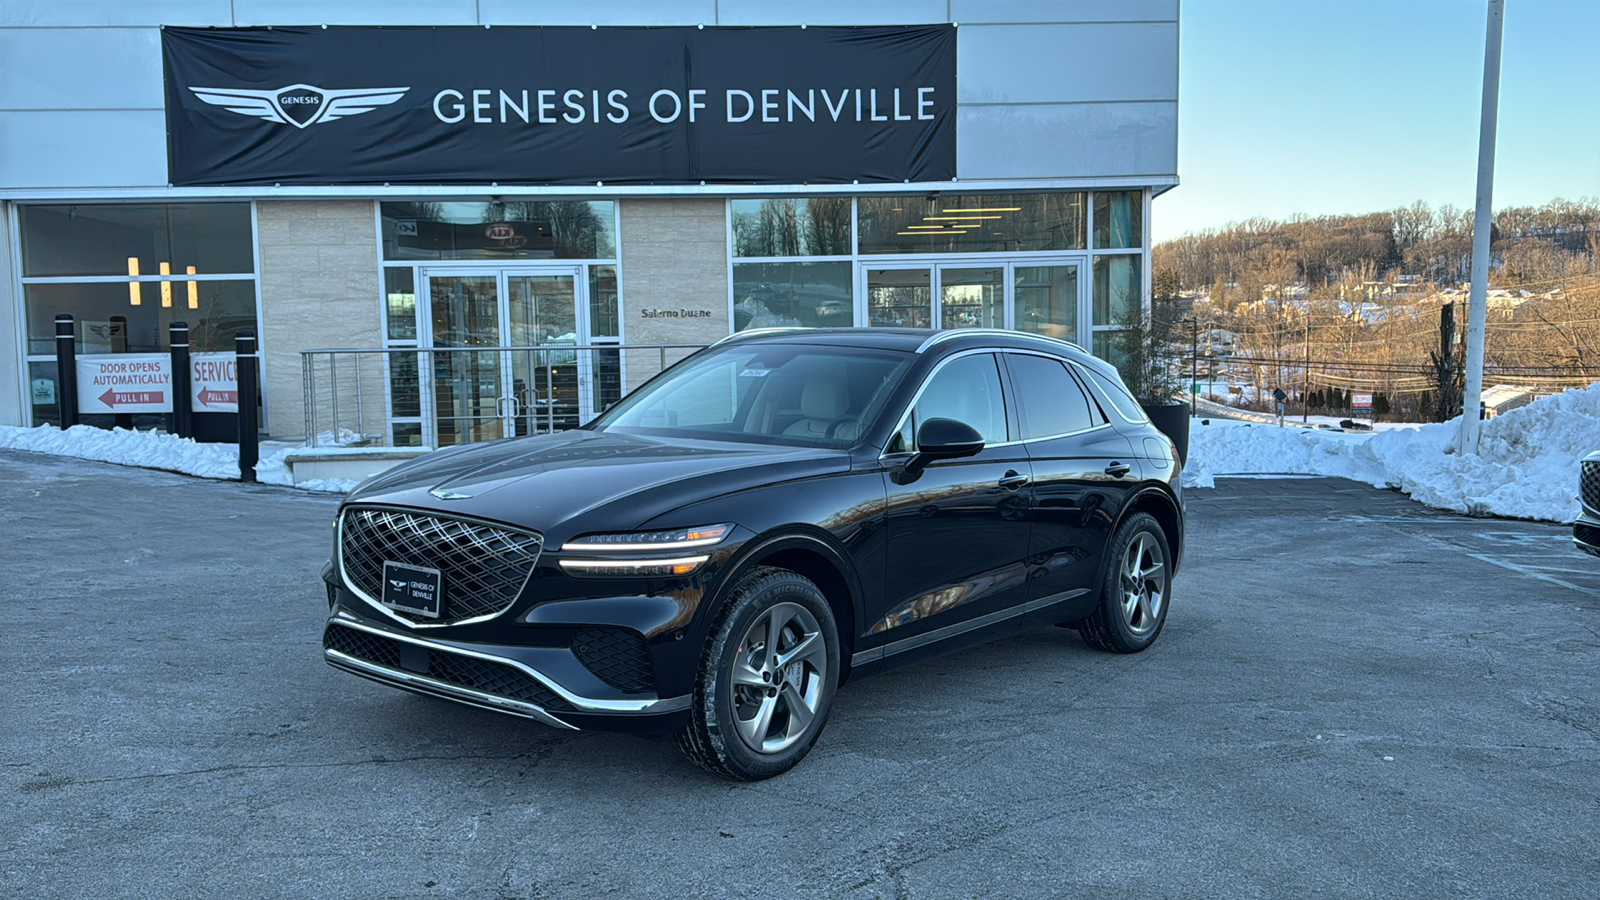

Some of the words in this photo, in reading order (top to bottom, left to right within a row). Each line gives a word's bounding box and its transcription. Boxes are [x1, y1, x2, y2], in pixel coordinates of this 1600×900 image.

[281, 96, 319, 104] GENESIS
[432, 88, 630, 124] GENESIS
[648, 88, 707, 124] OF
[726, 86, 935, 123] DENVILLE
[641, 308, 679, 318] Salerno
[681, 308, 712, 318] Duane
[100, 363, 127, 374] DOOR
[129, 361, 161, 373] OPENS
[92, 373, 170, 386] AUTOMATICALLY
[115, 393, 137, 403] PULL
[140, 393, 150, 402] IN
[207, 392, 222, 401] PULL
[410, 581, 428, 591] GENESIS
[428, 584, 435, 592] OF
[412, 590, 433, 600] DENVILLE
